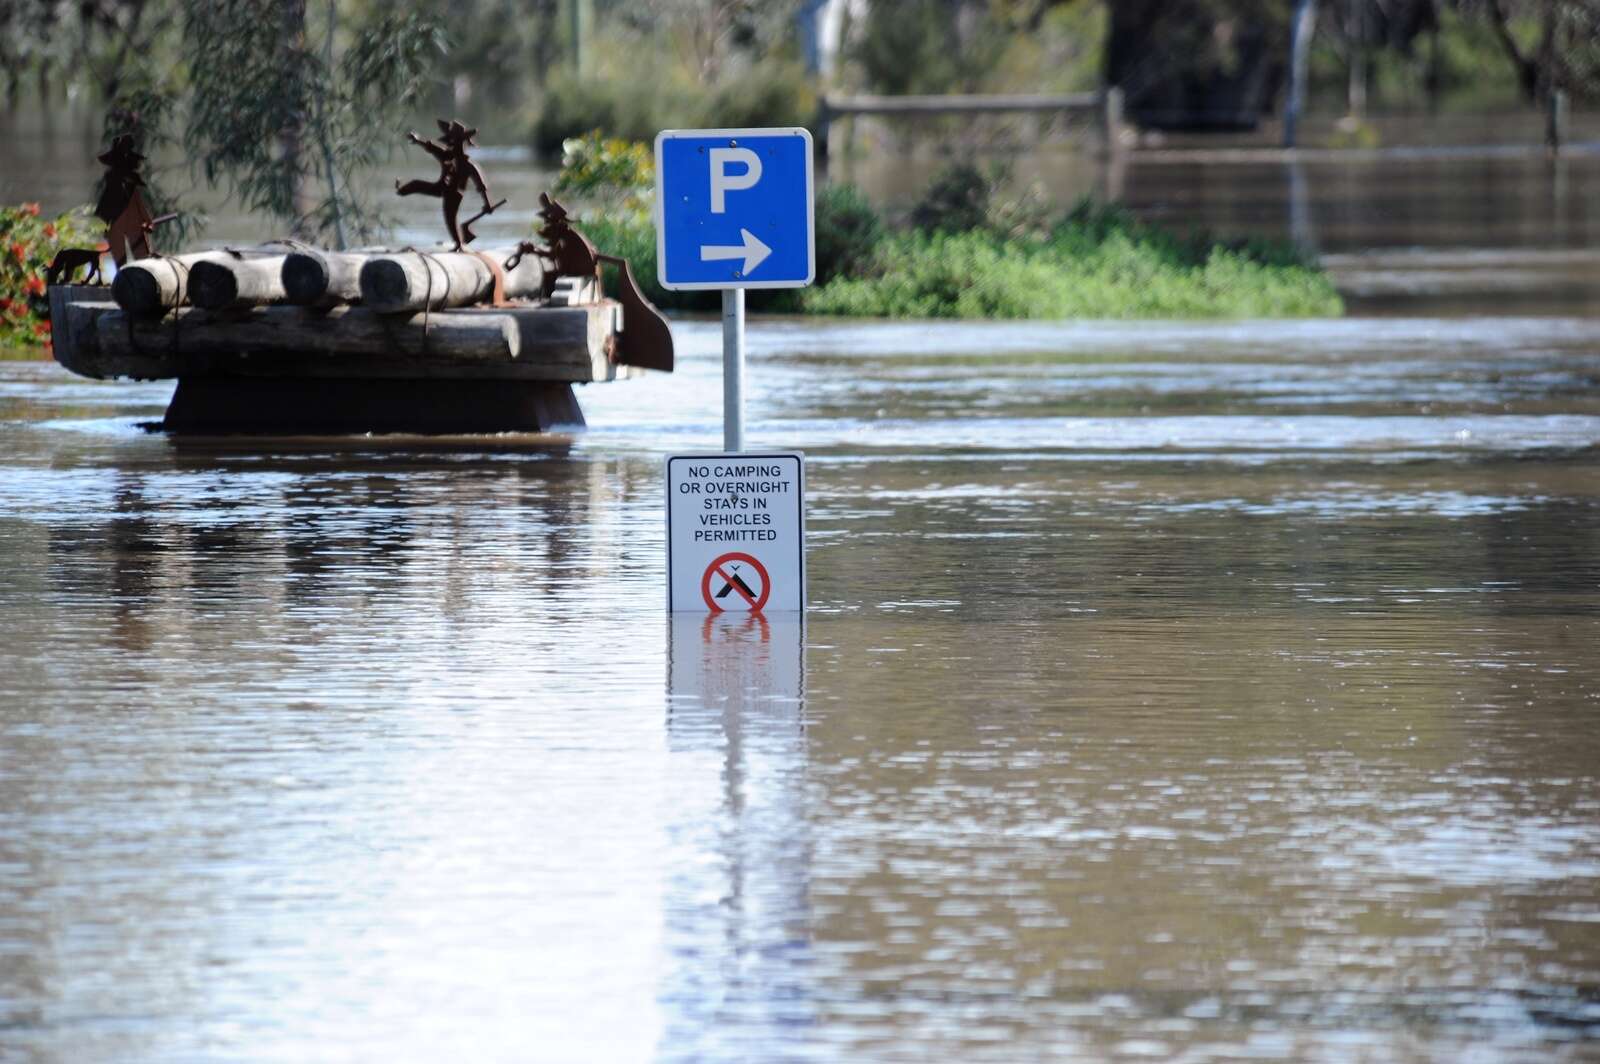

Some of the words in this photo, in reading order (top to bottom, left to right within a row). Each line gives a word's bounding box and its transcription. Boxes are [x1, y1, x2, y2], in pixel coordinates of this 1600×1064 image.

[709, 147, 763, 214] P
[688, 466, 710, 478] NO
[714, 465, 781, 478] CAMPING
[679, 482, 701, 494] OR
[705, 481, 790, 494] OVERNIGHT
[703, 497, 749, 510] STAYS
[753, 497, 767, 509] IN
[699, 513, 771, 526] VEHICLES
[694, 529, 777, 542] PERMITTED
